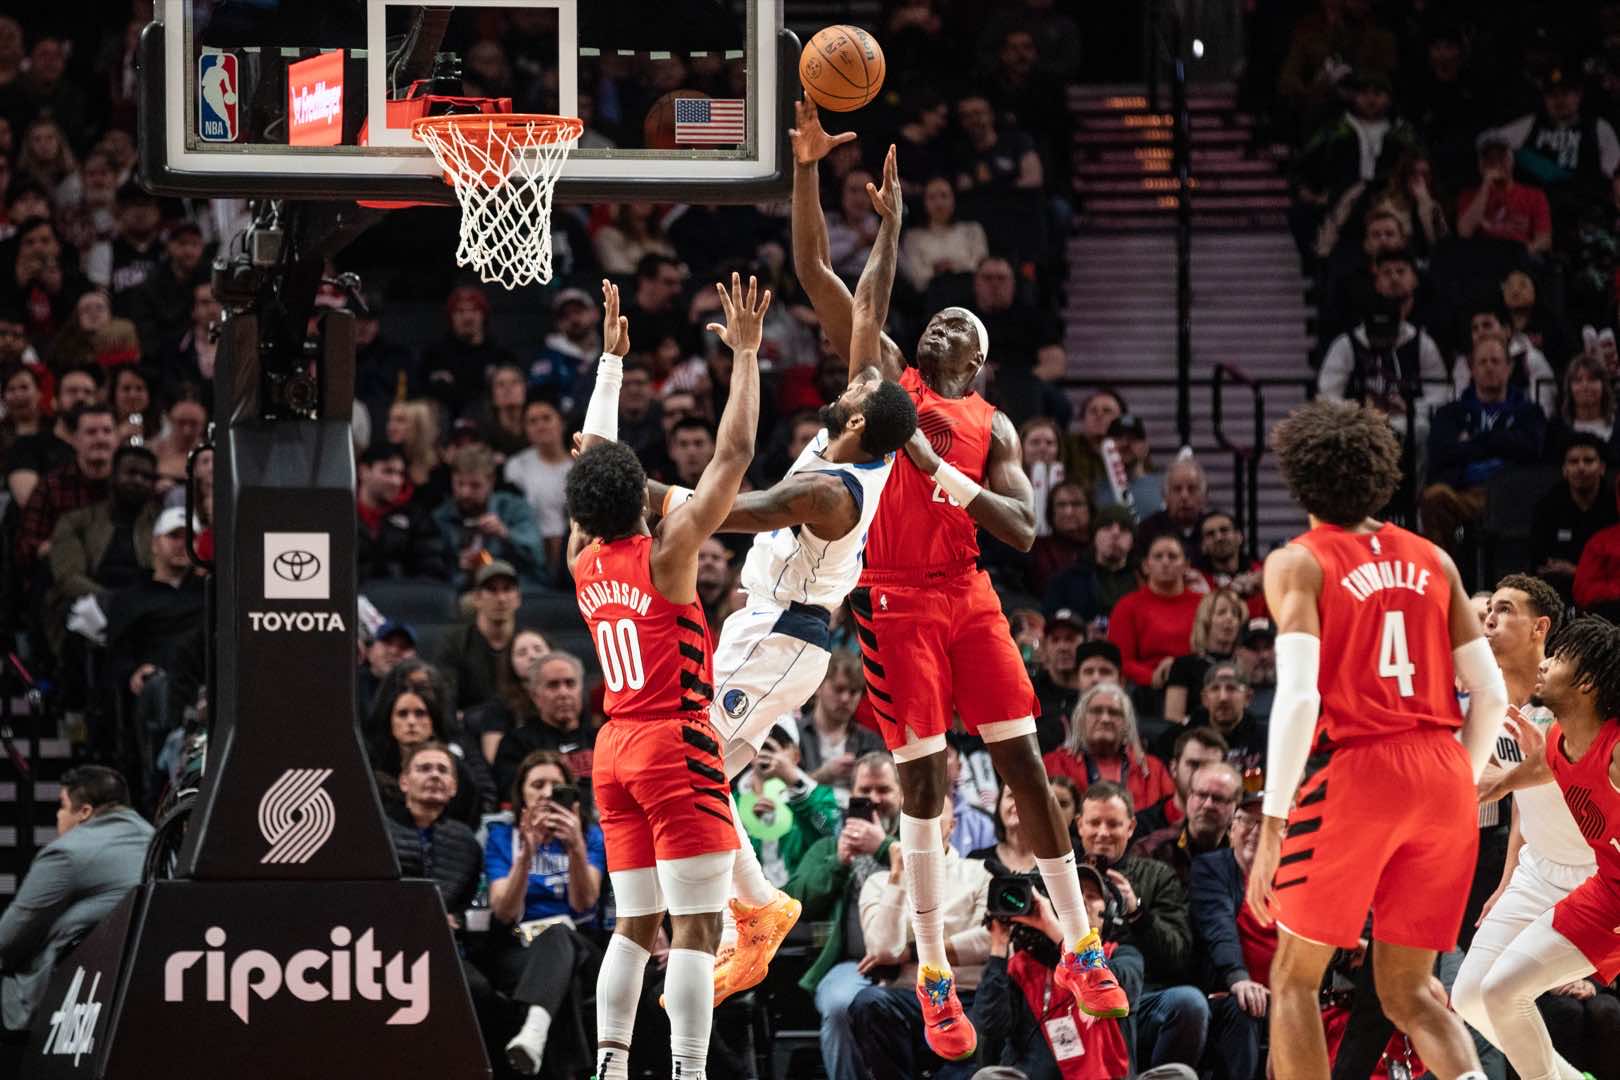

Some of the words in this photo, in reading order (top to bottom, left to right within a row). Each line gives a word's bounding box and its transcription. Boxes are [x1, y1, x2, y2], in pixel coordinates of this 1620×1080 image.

[205, 120, 224, 136] NBA
[248, 612, 346, 632] TOYOTA
[597, 618, 645, 692] 00
[1379, 611, 1415, 697] 4
